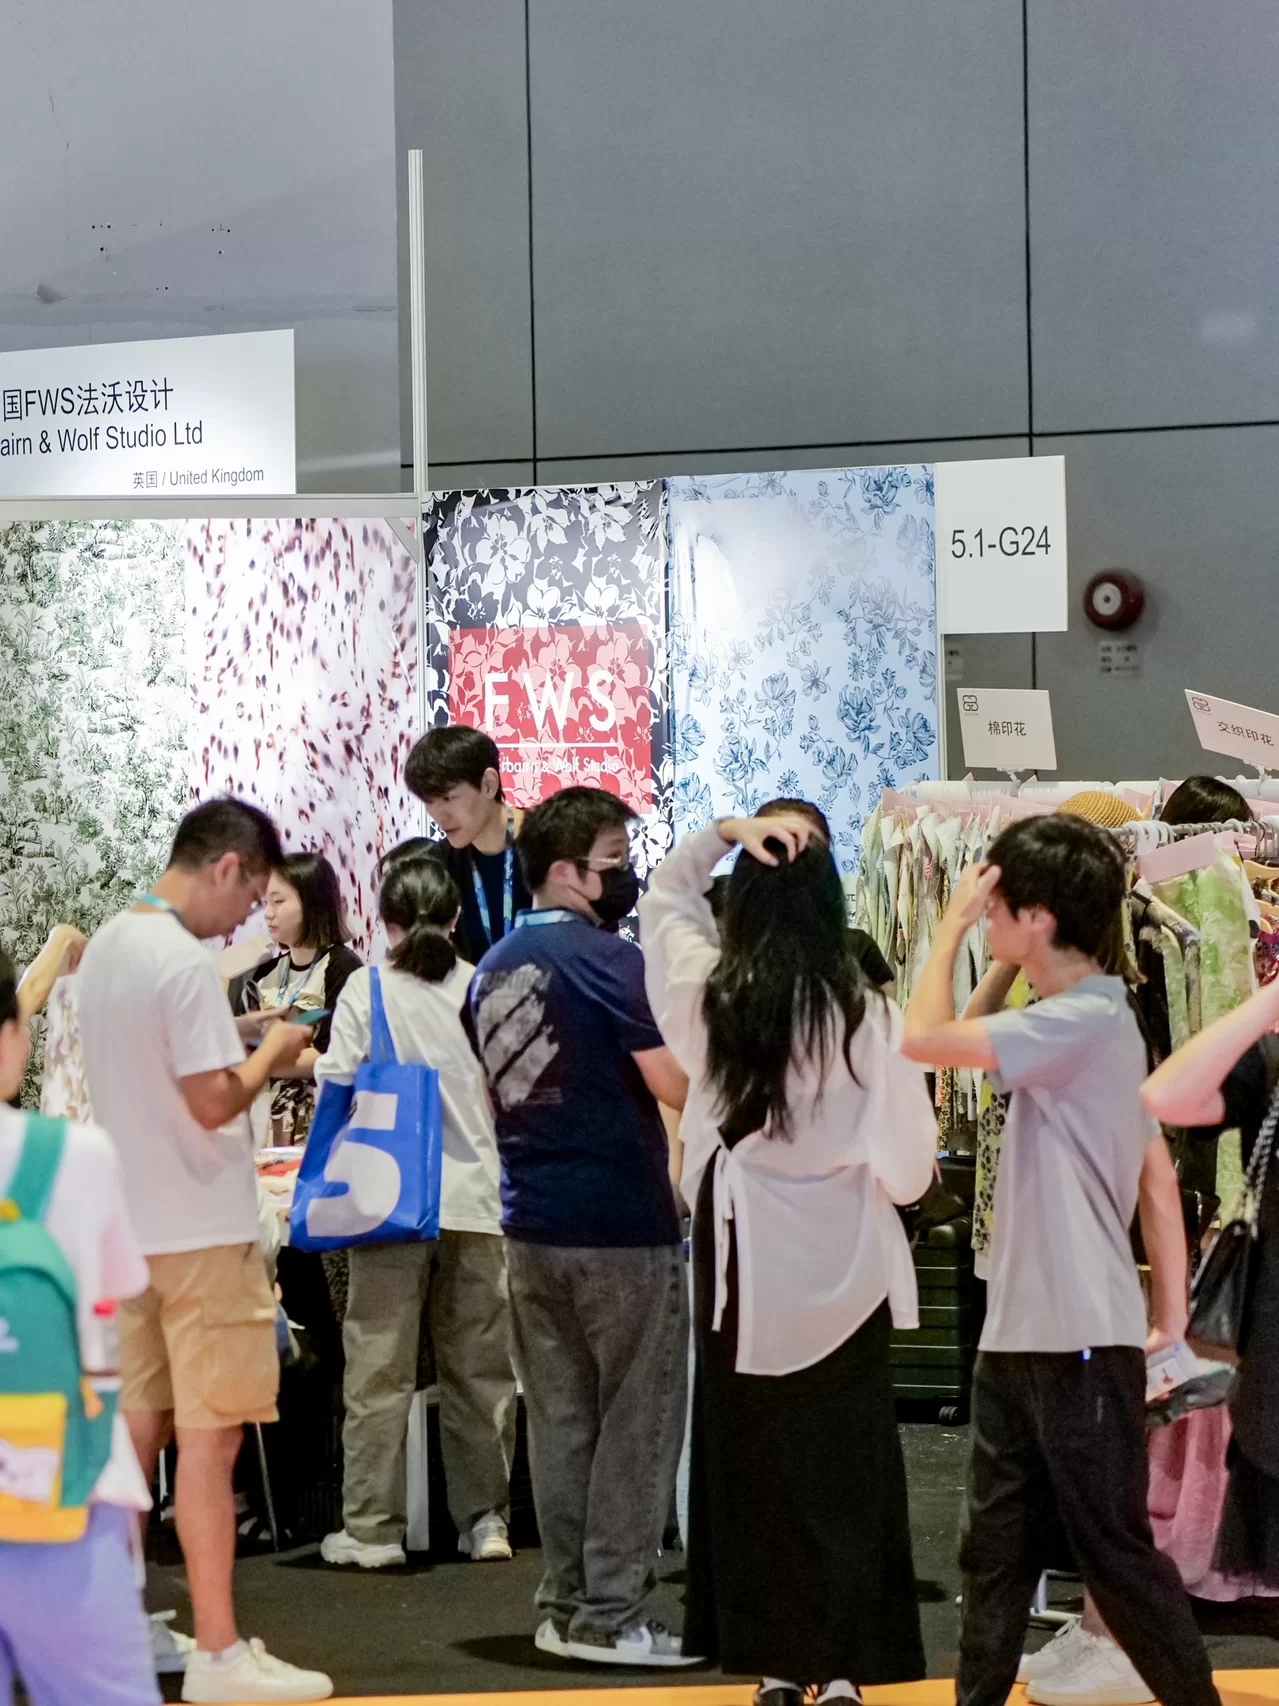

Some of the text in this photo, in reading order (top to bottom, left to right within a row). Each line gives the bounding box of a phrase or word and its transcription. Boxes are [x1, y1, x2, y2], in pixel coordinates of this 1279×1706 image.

[39, 430, 52, 453] &
[57, 427, 100, 453] Wolf
[105, 423, 167, 450] Studio
[173, 420, 203, 446] Ltd
[132, 470, 158, 489] 英国
[169, 469, 208, 486] United
[211, 467, 265, 486] Kingdom
[951, 525, 1052, 559] 5.1-G24
[484, 669, 617, 732] FWS
[987, 720, 1027, 737] 棉印花
[1216, 721, 1275, 747] 交织印花
[499, 756, 619, 773] irbairn & Wolf Studio
